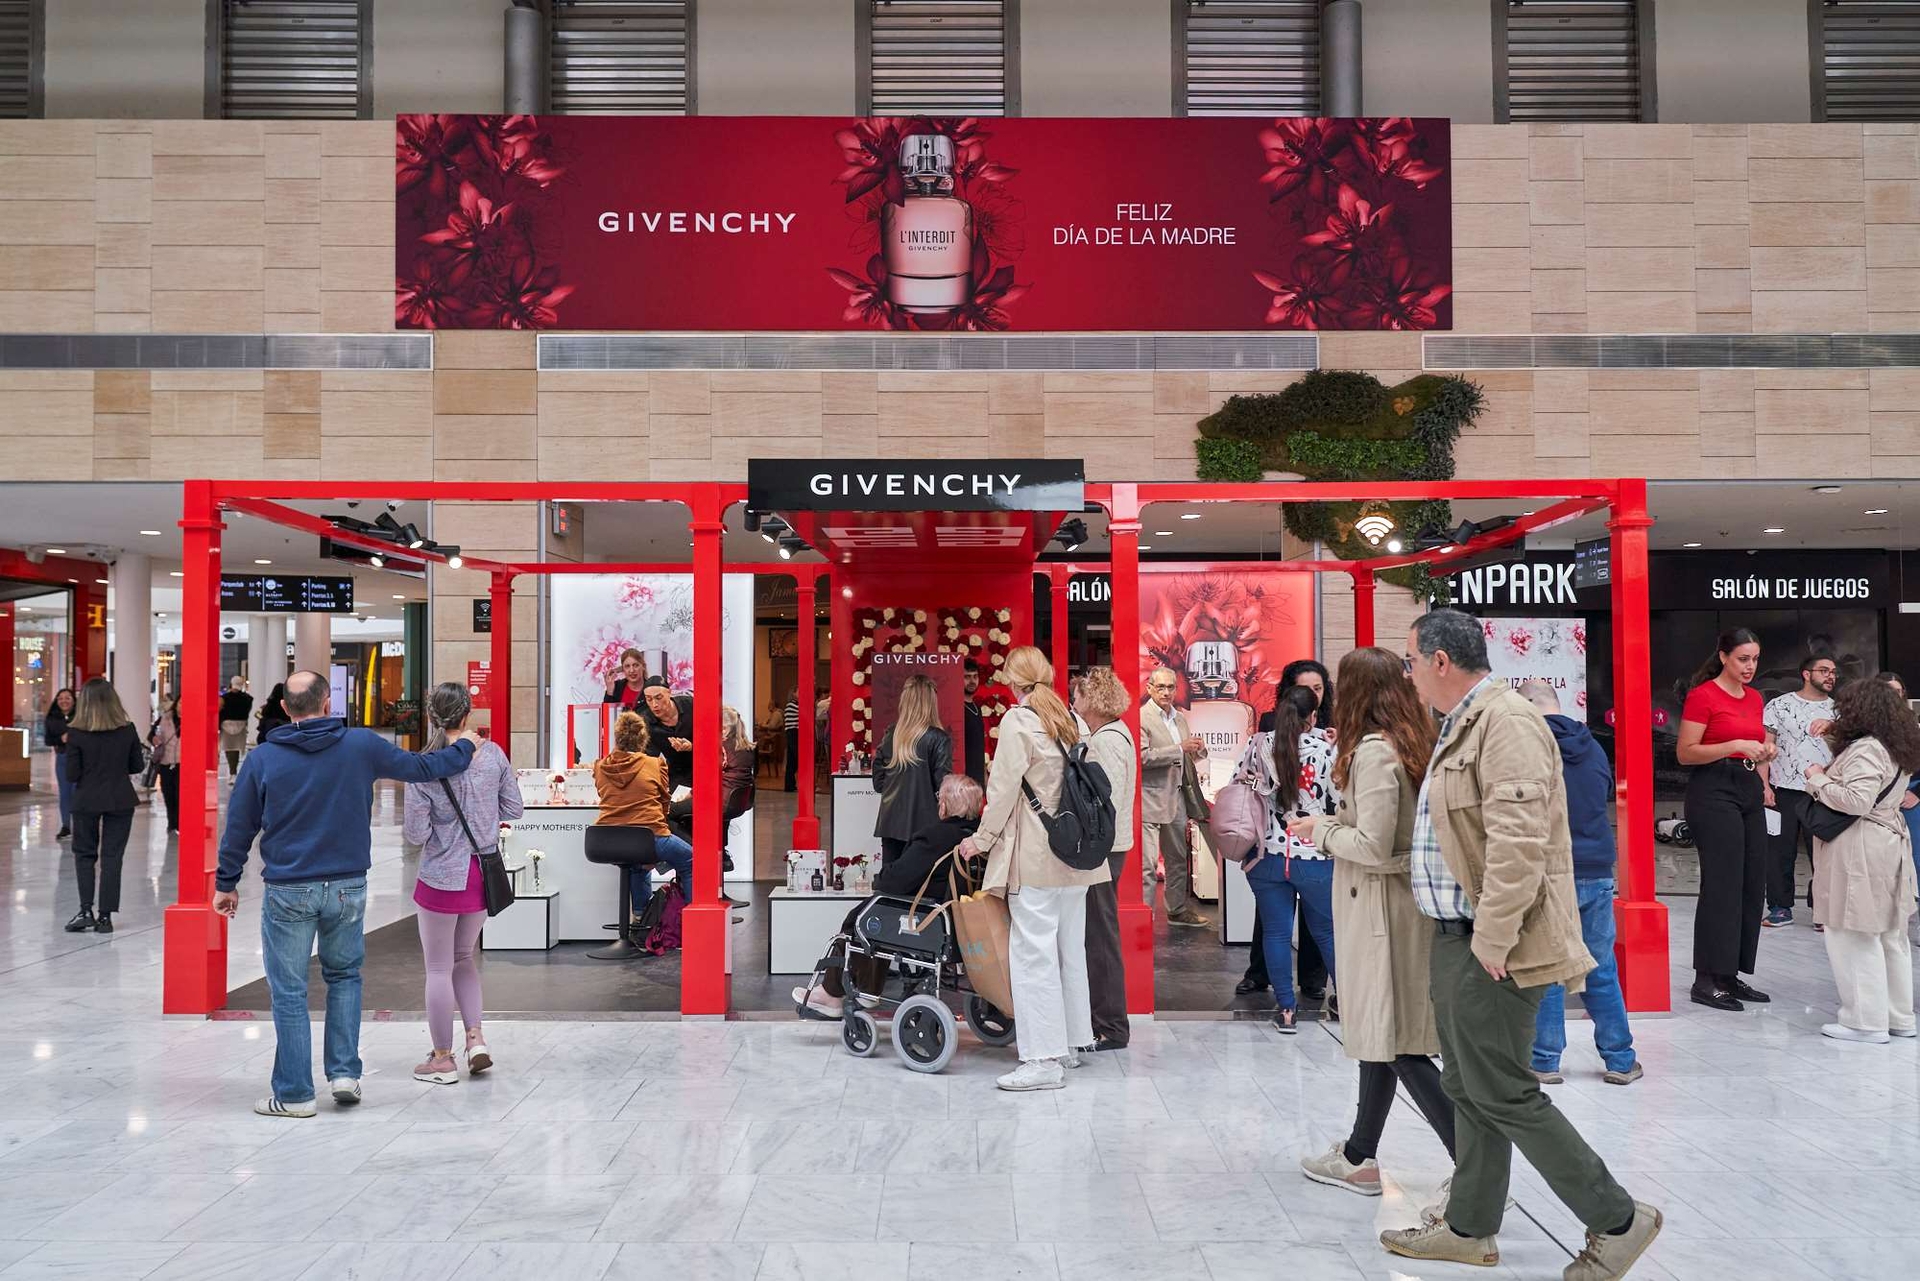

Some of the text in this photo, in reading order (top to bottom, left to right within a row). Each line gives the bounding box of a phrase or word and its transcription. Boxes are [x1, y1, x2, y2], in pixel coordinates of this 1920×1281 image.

[598, 211, 797, 233] GIVENCHY
[1116, 203, 1173, 221] FELIZ
[900, 230, 956, 244] L'INTERDIT
[1053, 223, 1236, 245] DÍA DE LA MADRE
[809, 473, 1022, 496] GIVENCHY
[1066, 577, 1111, 602] ALÓN
[1712, 574, 1869, 599] SALÓN DE JUEGOS
[873, 654, 961, 664] GIVENCHY
[1554, 677, 1566, 688] LA
